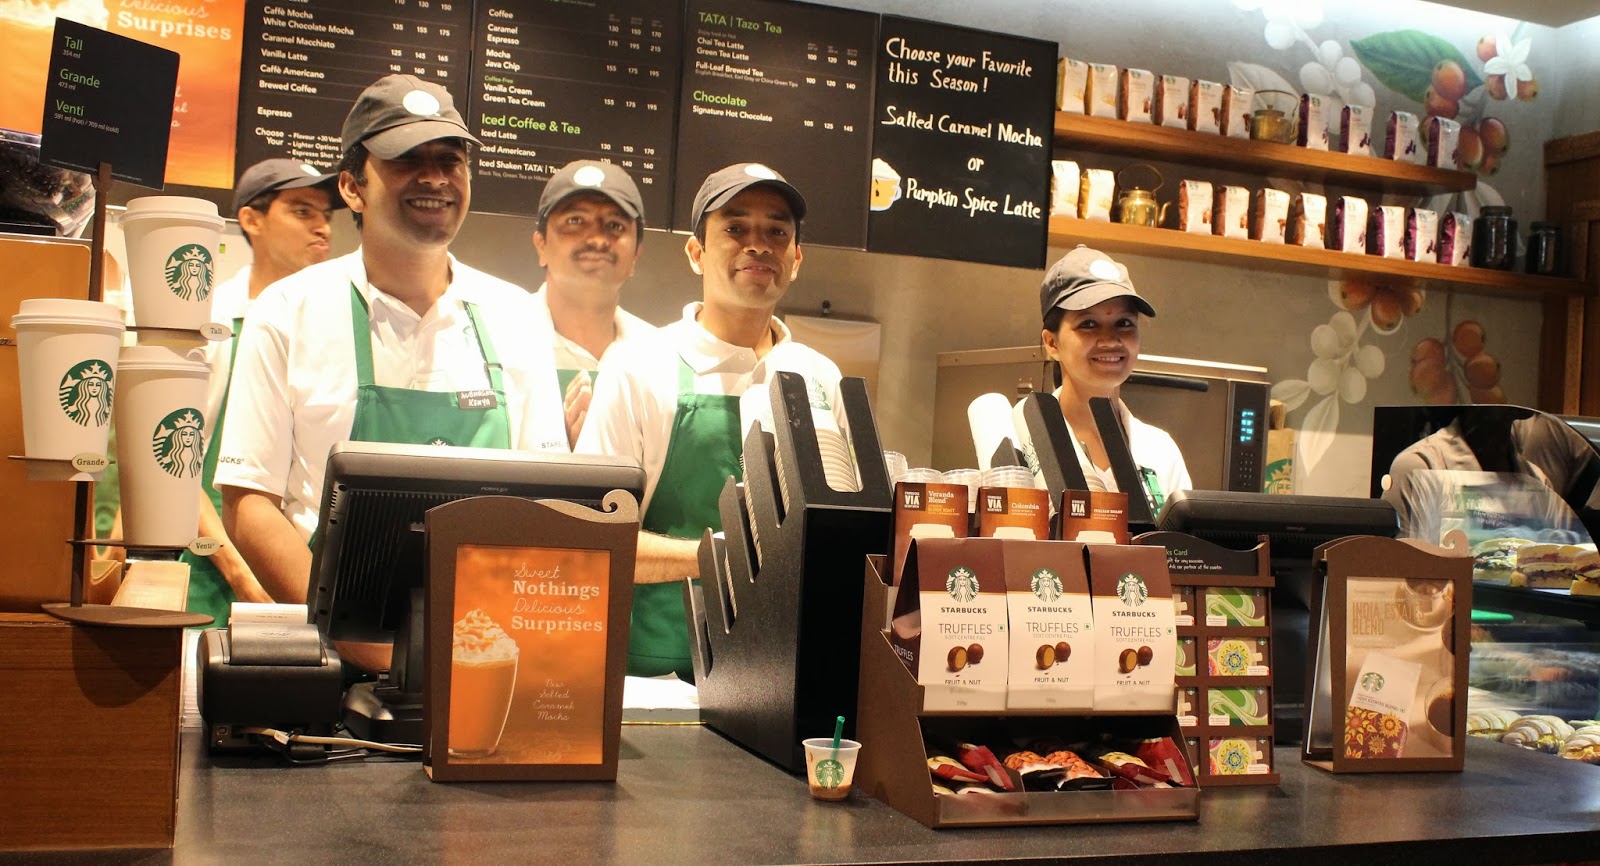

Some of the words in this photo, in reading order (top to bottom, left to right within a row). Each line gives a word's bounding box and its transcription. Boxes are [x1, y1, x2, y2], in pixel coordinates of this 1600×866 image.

[287, 9, 314, 20] Mocha
[488, 8, 514, 19] Coffee
[117, 11, 232, 40] Surprises
[262, 16, 286, 27] White
[288, 20, 327, 32] Chocolate
[328, 25, 354, 36] Mocha
[487, 24, 518, 34] Caramel
[699, 12, 727, 26] TATA
[736, 18, 760, 30] Tazo
[764, 22, 782, 34] Tea
[64, 36, 83, 51] Tall
[262, 32, 295, 44] Caramel
[296, 36, 336, 49] Macchiato
[486, 34, 520, 46] Espresso
[697, 36, 713, 46] Chai
[713, 38, 726, 47] Tea
[726, 41, 744, 50] Latte
[260, 48, 286, 58] Vanilla
[288, 51, 308, 62] Latte
[390, 49, 402, 57] 125
[486, 49, 511, 60] Mocha
[696, 47, 718, 56] Green
[718, 50, 730, 58] Tea
[732, 52, 750, 60] Latte
[886, 37, 940, 62] Choose
[946, 53, 976, 69] your
[982, 51, 1032, 78] Favorite
[484, 60, 502, 69] Java
[502, 61, 520, 72] Chip
[695, 61, 724, 72] Full-Leaf
[725, 64, 750, 76] Brewed
[752, 68, 764, 77] Tea
[60, 68, 100, 88] Grande
[283, 66, 325, 79] Americano
[888, 62, 918, 84] this
[930, 69, 978, 92] Season
[58, 81, 68, 89] 473
[258, 80, 289, 92] Brewed
[290, 82, 318, 94] Coffee
[483, 82, 508, 93] Vanilla
[508, 85, 532, 96] Cream
[483, 94, 506, 104] Green
[507, 96, 520, 105] Tea
[522, 98, 546, 108] Cream
[693, 90, 748, 107] Chocolate
[56, 100, 84, 116] Venti
[257, 106, 292, 118] Espresso
[692, 104, 724, 117] Signature
[725, 109, 738, 118] Hot
[740, 110, 773, 122] Chocolate
[482, 113, 506, 126] Iced
[508, 116, 546, 131] Coffee
[549, 120, 558, 132] &
[560, 122, 581, 136] Tea
[804, 120, 814, 128] 105
[844, 124, 854, 132] 145
[881, 105, 933, 130] Salted
[938, 115, 992, 138] Caramel
[998, 123, 1043, 148] Mocha
[255, 127, 284, 138] Choose
[293, 132, 315, 140] Flavour
[480, 129, 497, 138] Iced
[498, 130, 518, 140] Latte
[266, 136, 284, 146] Your
[292, 141, 314, 149] Lighter
[315, 143, 340, 151] Options
[292, 149, 319, 158] Espresso
[496, 146, 536, 157] Americano
[314, 160, 332, 168] charge
[479, 159, 495, 168] Iced
[496, 160, 522, 170] Shaken
[524, 164, 543, 172] TATA
[968, 157, 984, 172] or
[906, 177, 958, 209] Pumpkin
[962, 188, 998, 218] Spice
[1003, 194, 1041, 219] Latte
[76, 458, 105, 467] Grande
[220, 456, 242, 464] UCKS
[904, 494, 920, 505] VIA
[987, 498, 1002, 509] VIA
[1072, 503, 1085, 514] VIA
[514, 562, 560, 579] Sweet
[512, 580, 600, 600] Nothings
[512, 598, 584, 614] Delicious
[511, 616, 603, 634] Surprises
[938, 623, 992, 634] TRUFFLES
[1026, 622, 1079, 634] TRUFFLES
[1110, 626, 1162, 638] TRUFFLES
[533, 700, 574, 710] Caramel
[538, 711, 570, 720] Mocha
